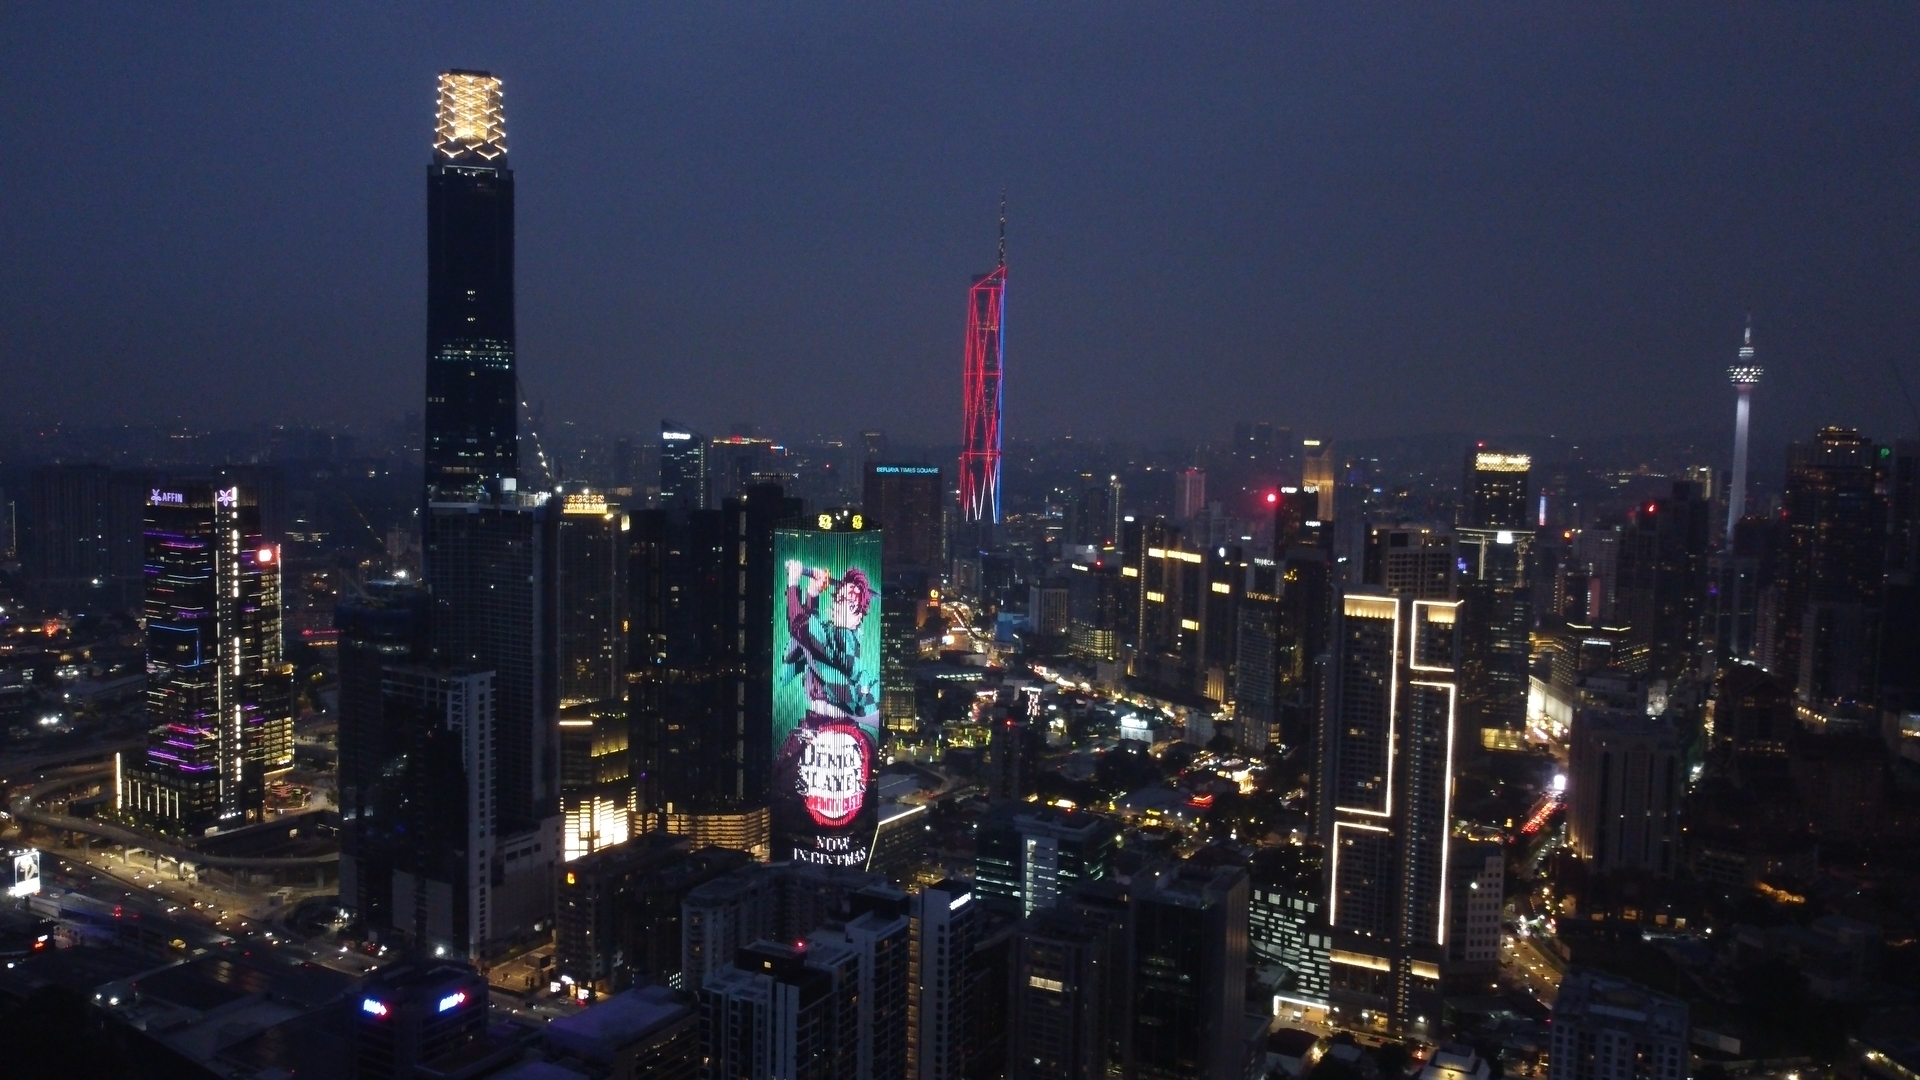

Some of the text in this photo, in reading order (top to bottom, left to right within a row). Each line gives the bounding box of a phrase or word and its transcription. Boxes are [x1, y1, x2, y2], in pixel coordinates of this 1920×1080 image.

[162, 492, 183, 503] AFFIN
[796, 768, 866, 796] SLAYER
[815, 835, 850, 852] NOW
